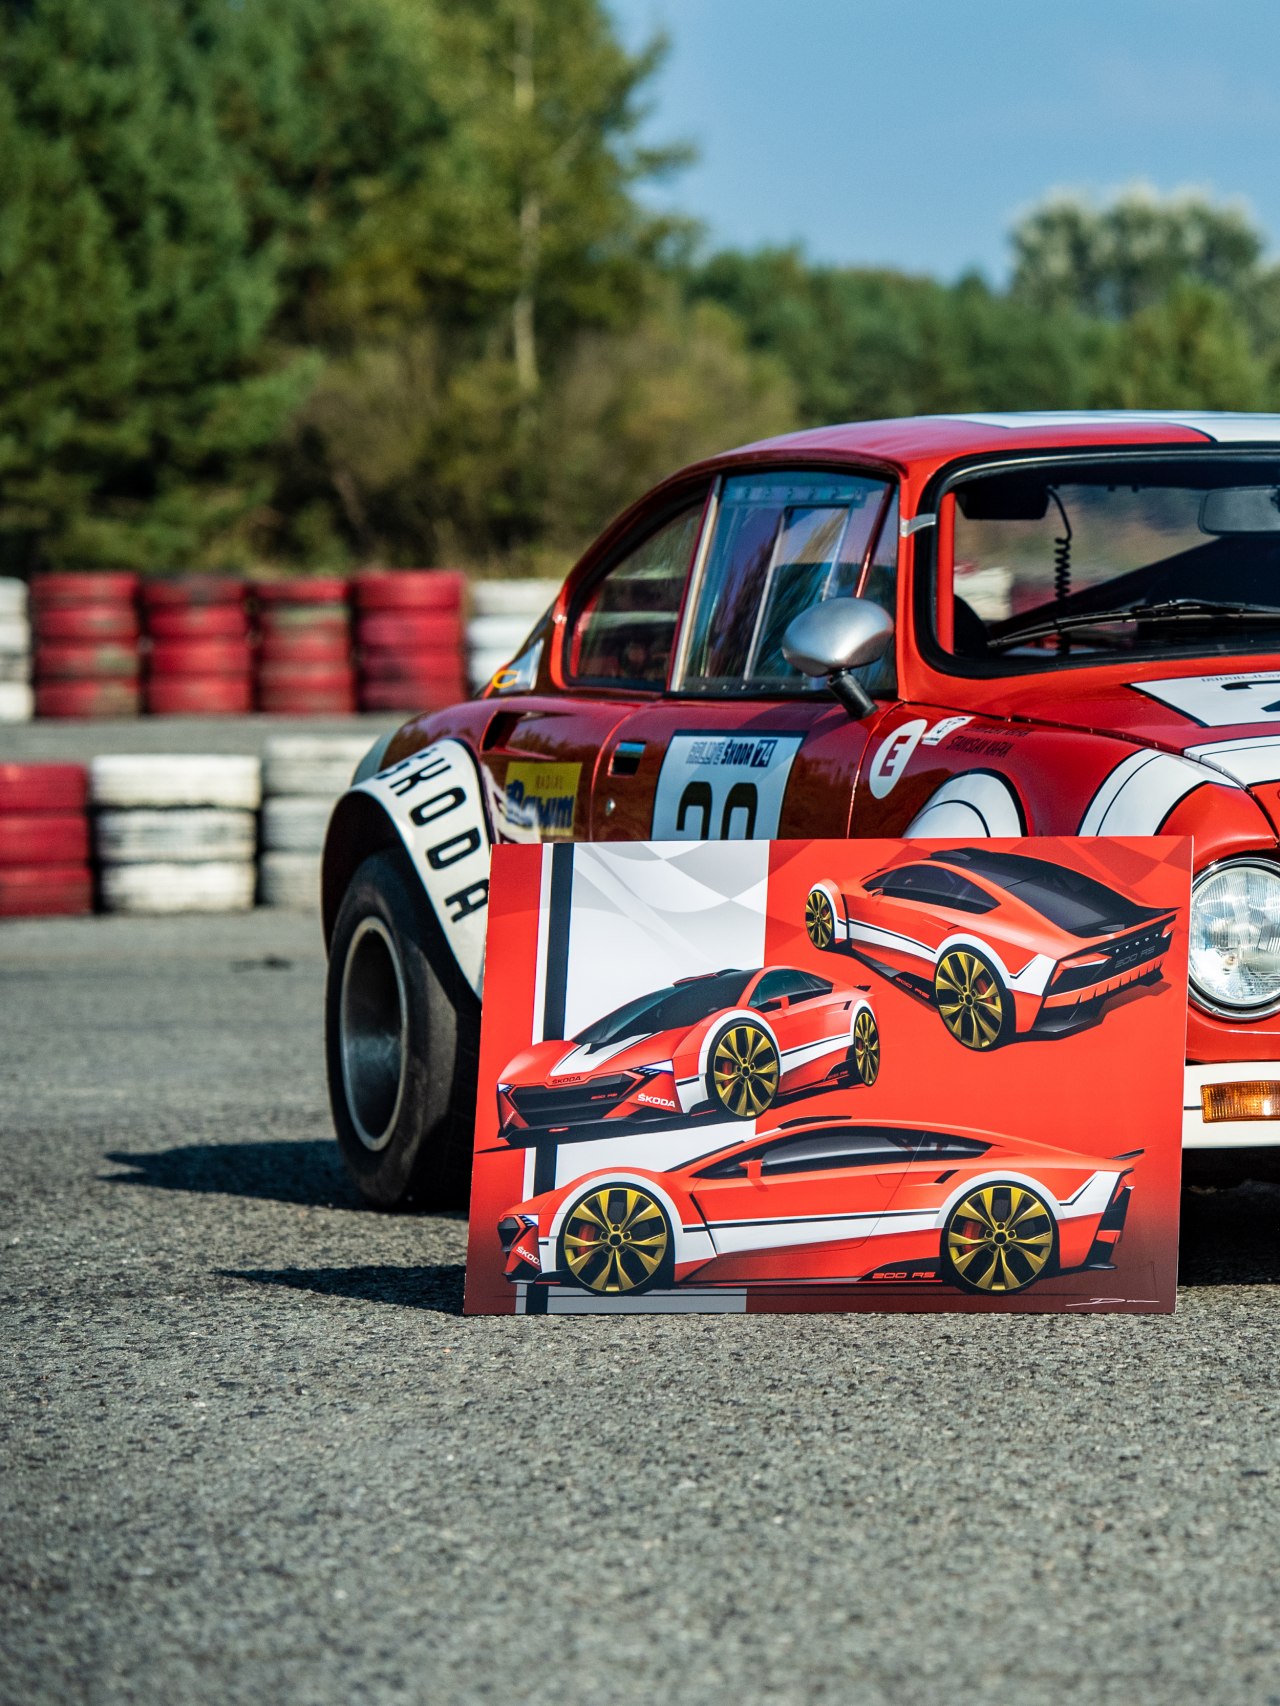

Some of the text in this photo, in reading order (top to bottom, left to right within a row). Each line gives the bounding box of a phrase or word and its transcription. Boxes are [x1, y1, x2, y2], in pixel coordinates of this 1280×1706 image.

[552, 1076, 582, 1085] ŠKODA
[637, 1093, 676, 1108] ŠKODA
[912, 1271, 936, 1279] RS
